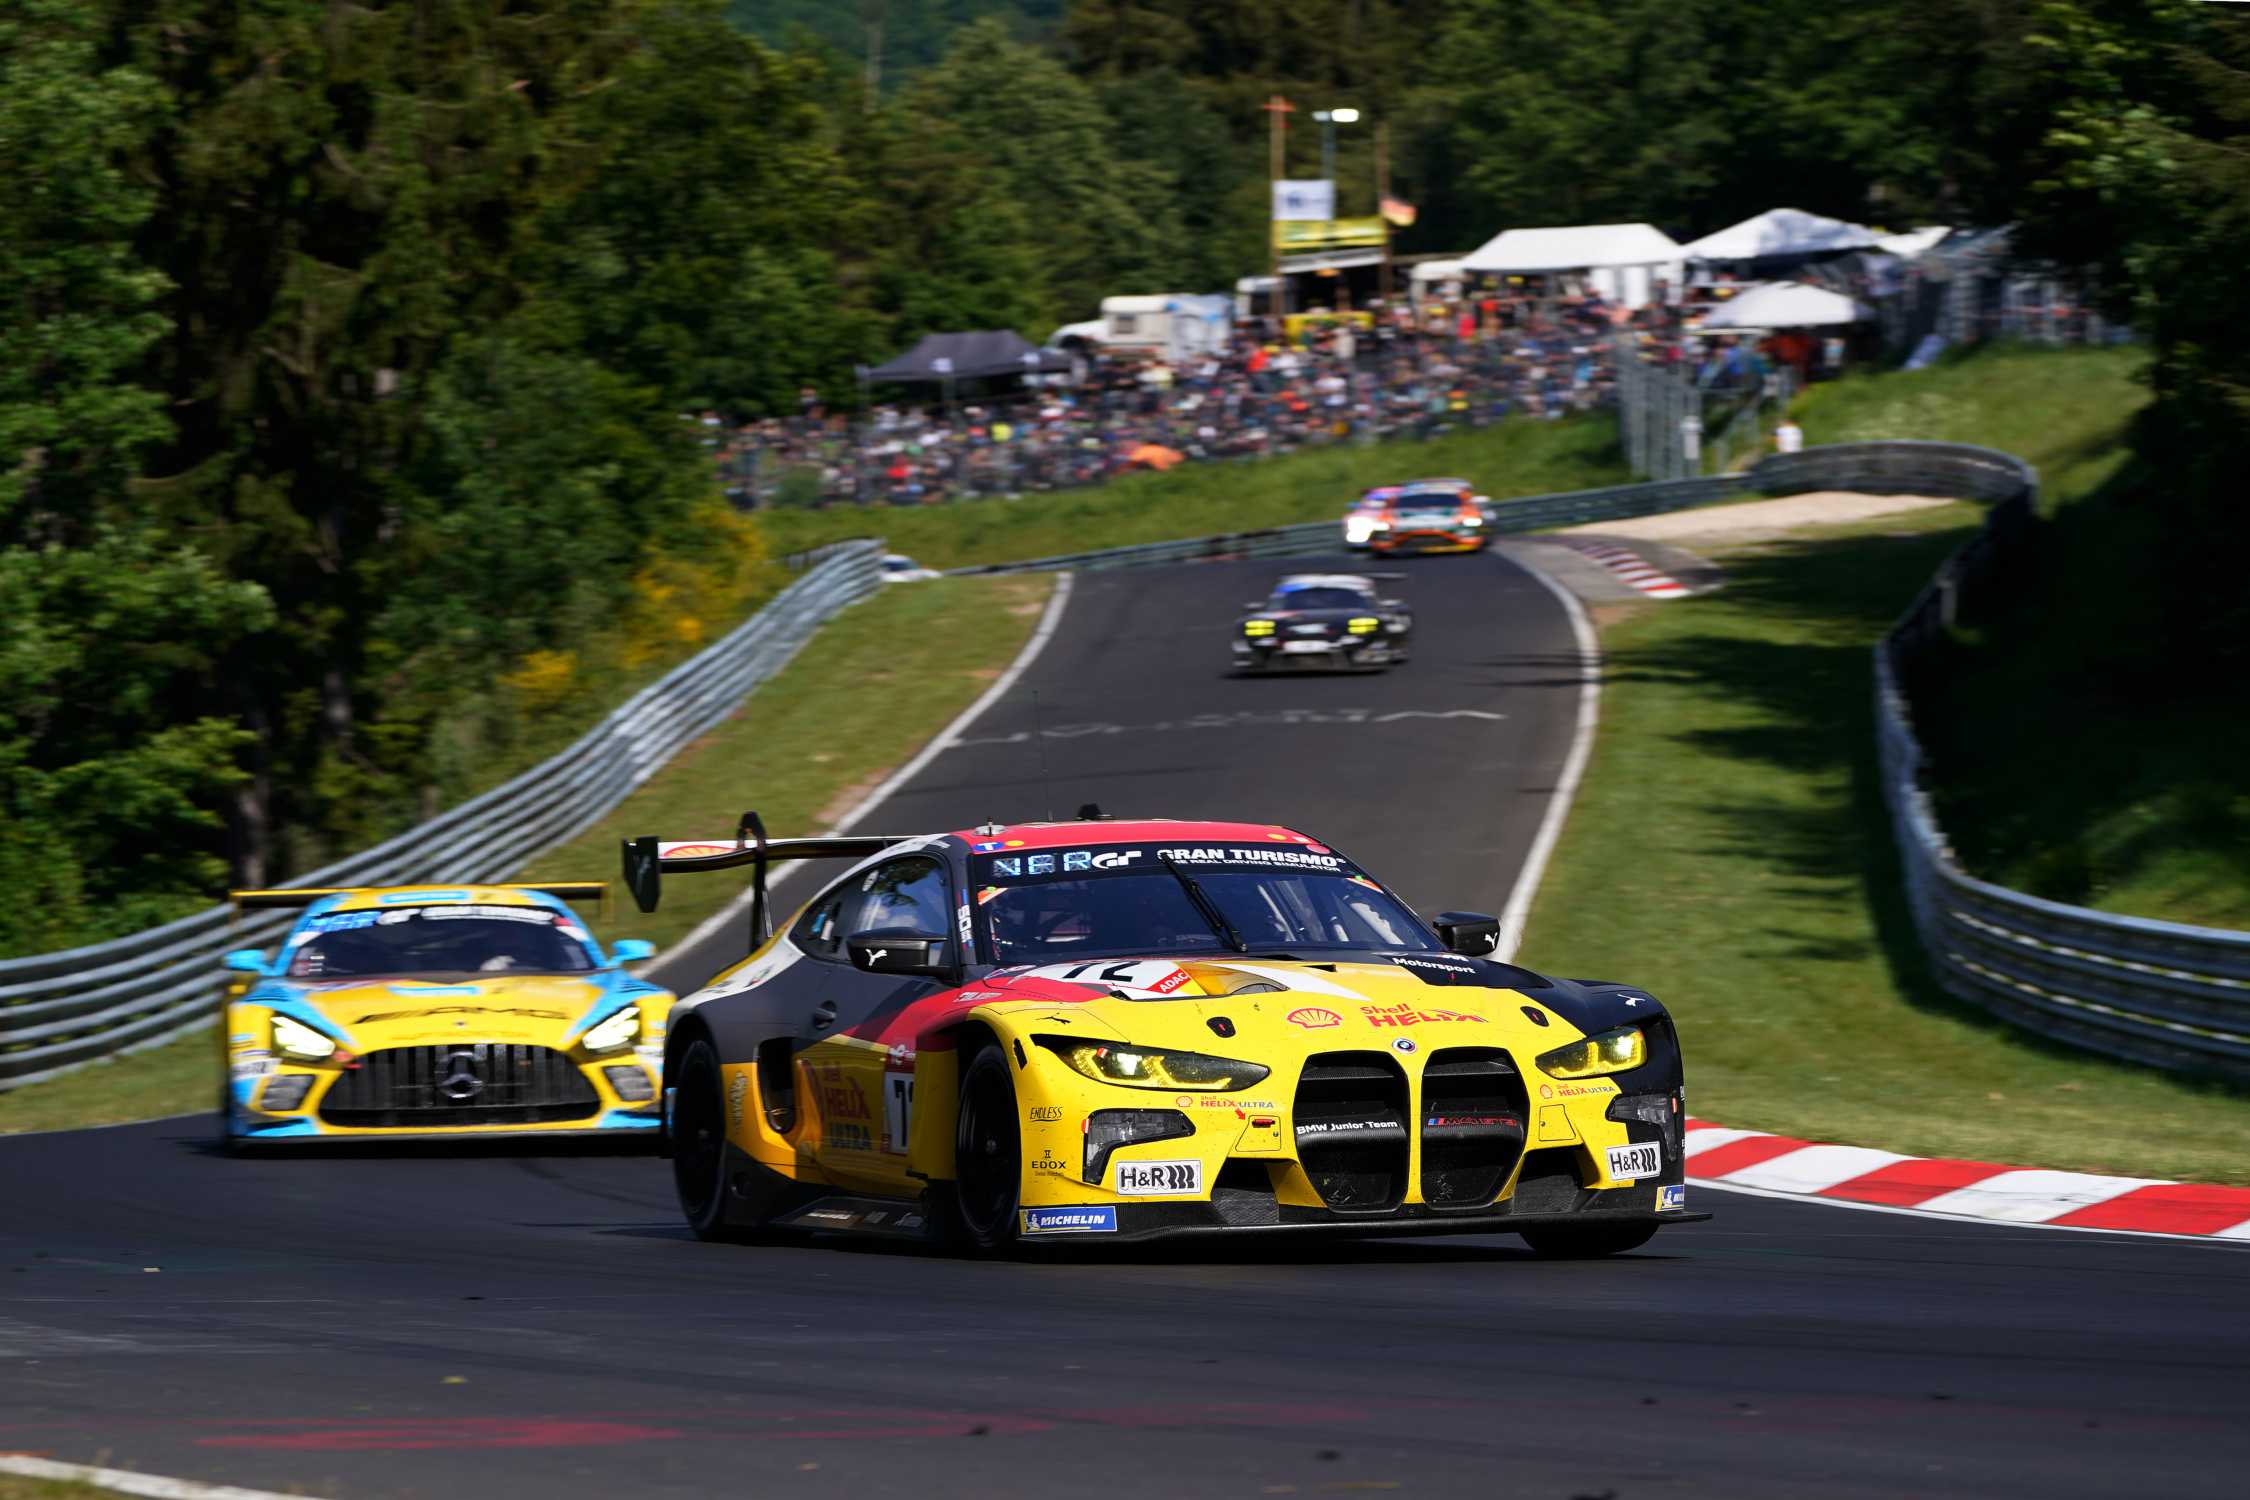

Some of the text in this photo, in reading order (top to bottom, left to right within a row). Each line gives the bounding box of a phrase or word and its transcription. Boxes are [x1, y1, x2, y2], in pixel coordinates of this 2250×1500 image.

[1157, 849, 1339, 867] GRAN TURISMO
[1062, 961, 1143, 982] 72
[1392, 957, 1476, 974] Motorsport
[1159, 972, 1189, 992] ADAC
[1360, 1003, 1411, 1015] Shell
[1365, 1009, 1488, 1028] HELIX
[1558, 1086, 1615, 1096] HELIX ULTRA
[1200, 1099, 1237, 1107] HELIX
[893, 1079, 914, 1147] 7
[1029, 1106, 1063, 1121] ENDLESS
[1296, 1121, 1398, 1135] BMW Junior Team
[1031, 1160, 1067, 1170] EDOX
[1611, 1153, 1641, 1173] H&R
[1120, 1167, 1165, 1188] H&R
[1040, 1214, 1105, 1226] MICHELIN
